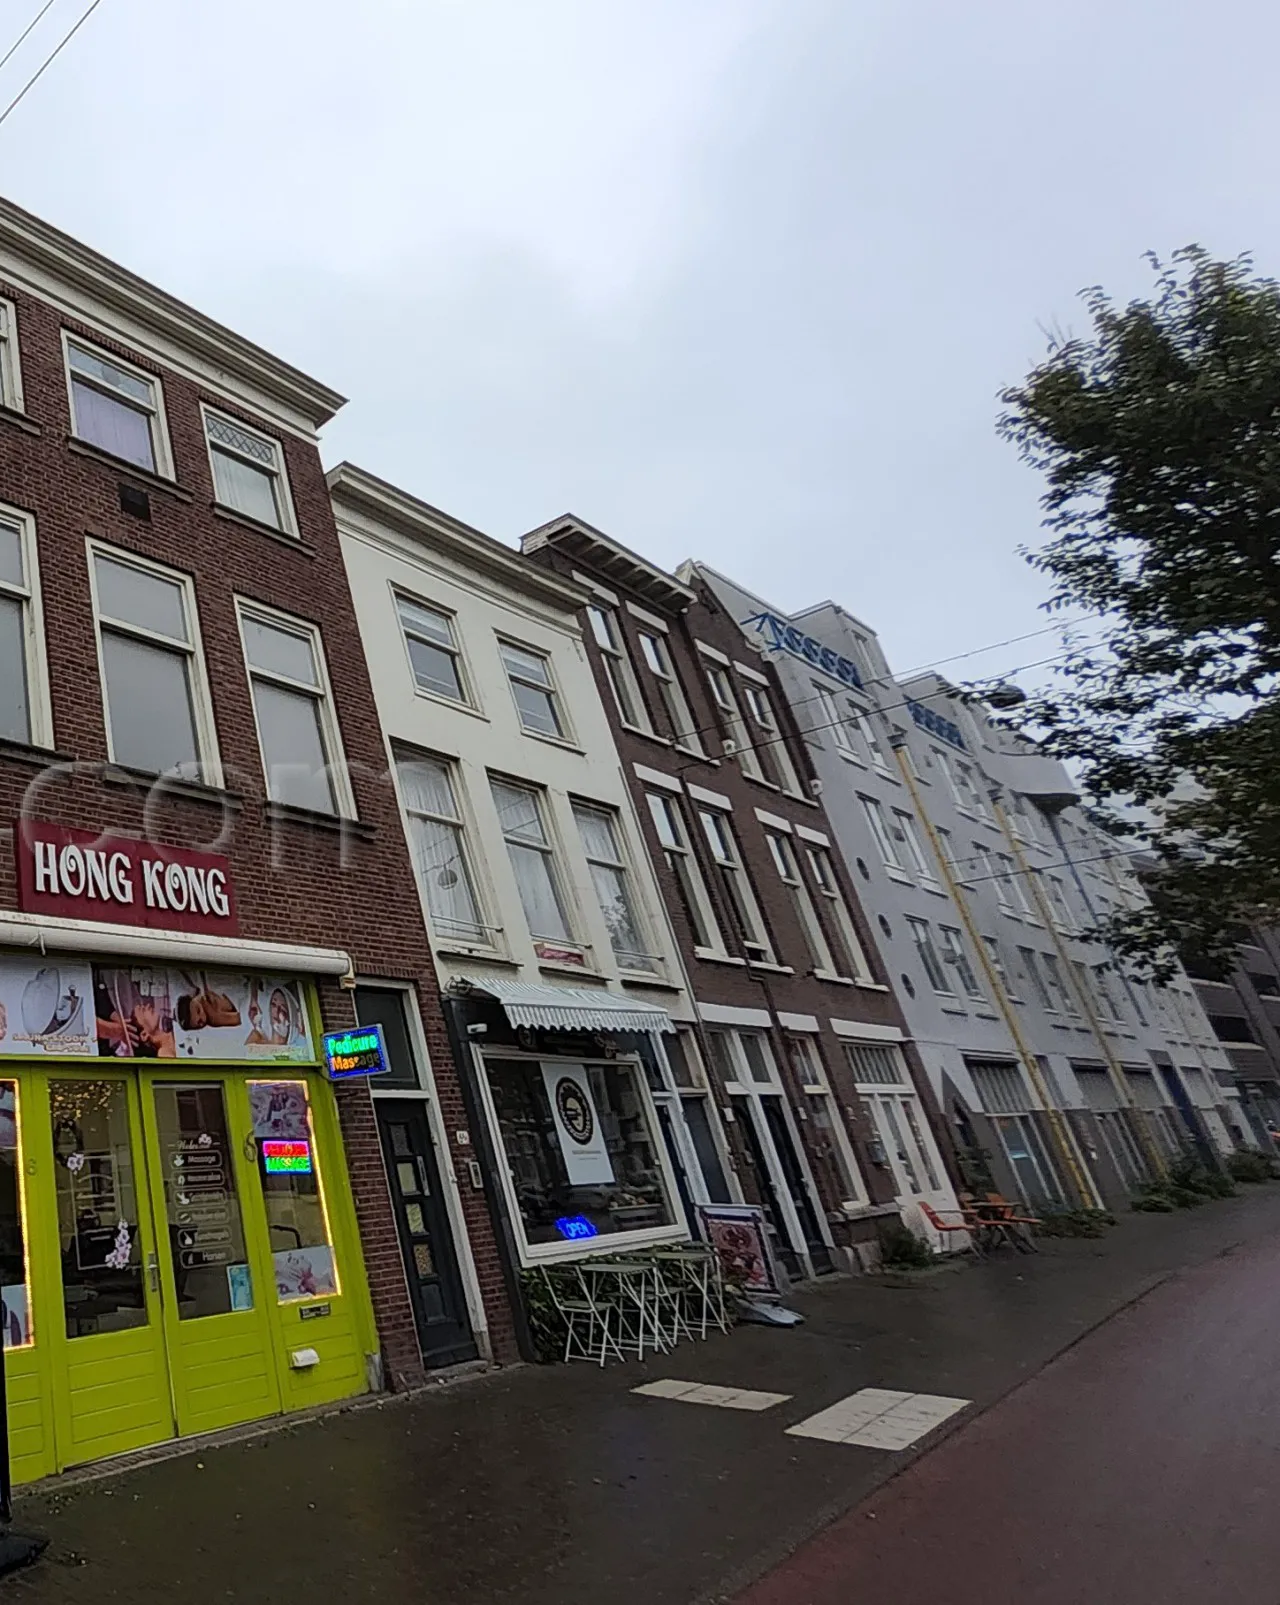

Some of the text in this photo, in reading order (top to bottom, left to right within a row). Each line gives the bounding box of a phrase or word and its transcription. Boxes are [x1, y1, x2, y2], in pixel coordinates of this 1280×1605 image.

[34, 841, 230, 917] HONG KONG
[327, 1034, 378, 1056] Pedicure
[329, 1053, 380, 1071] Massage
[566, 1221, 591, 1238] OPEN
